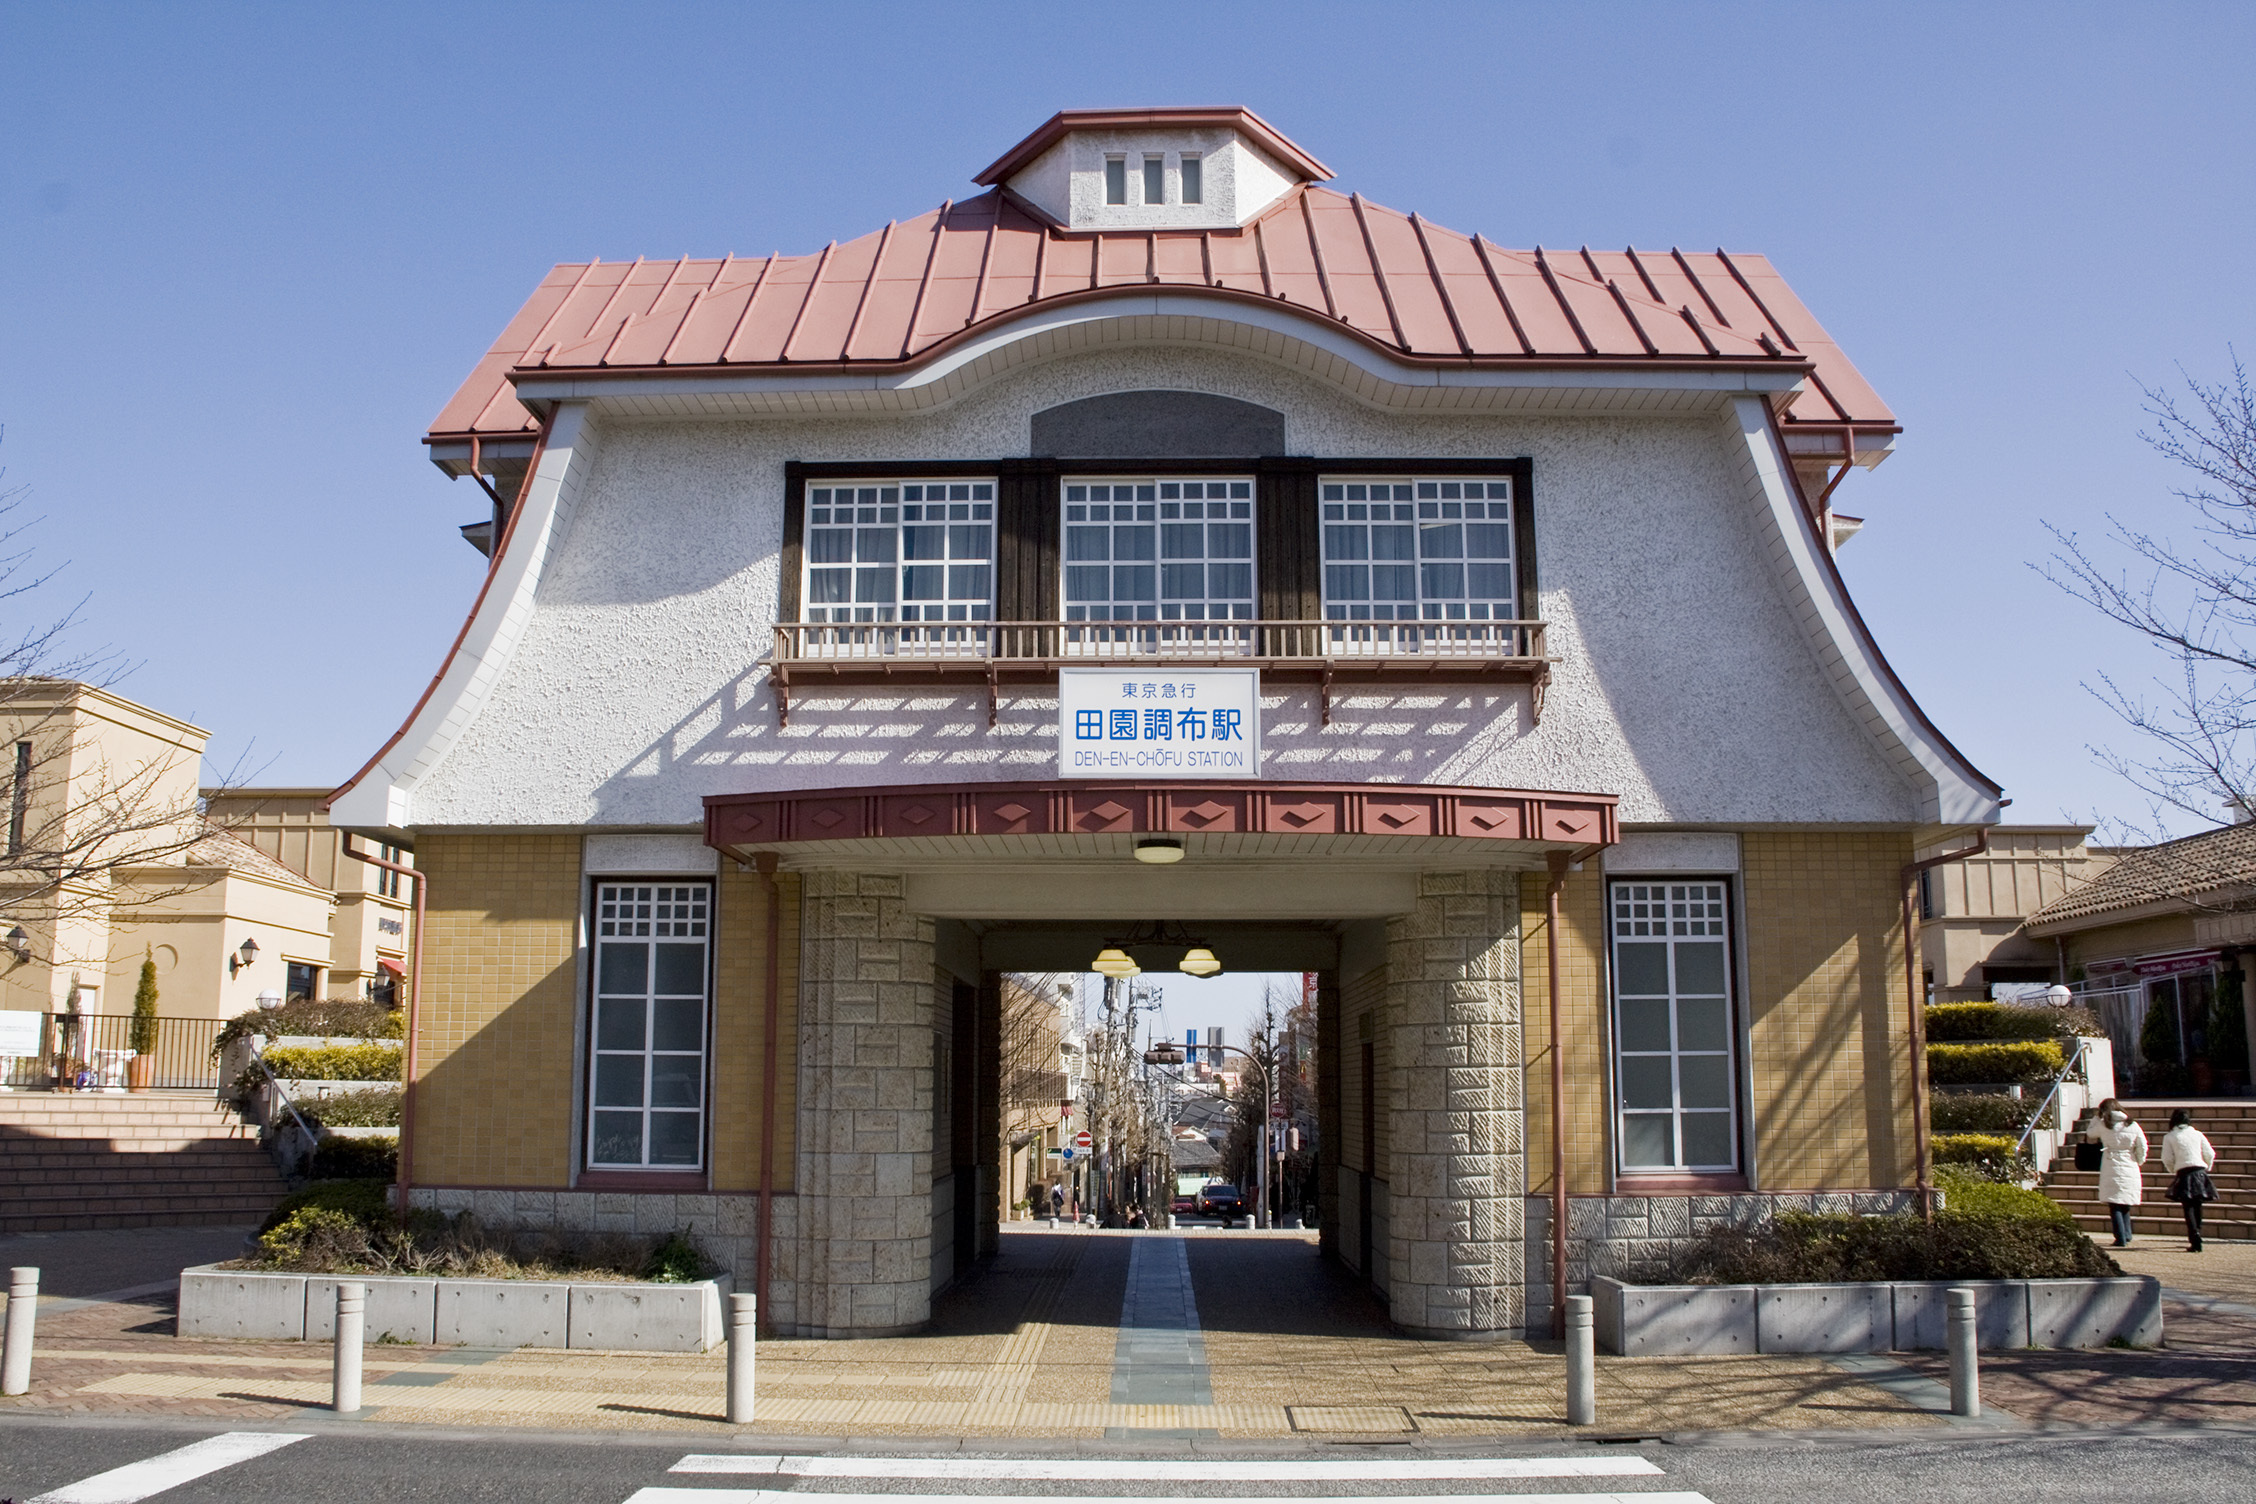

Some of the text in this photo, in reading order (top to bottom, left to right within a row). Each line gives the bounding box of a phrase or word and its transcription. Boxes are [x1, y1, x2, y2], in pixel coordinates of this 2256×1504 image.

[1122, 682, 1197, 699] 東京急行
[1075, 706, 1243, 742] 田園調布駅
[1075, 748, 1243, 767] DEN-EN-CHŌFU STATION
